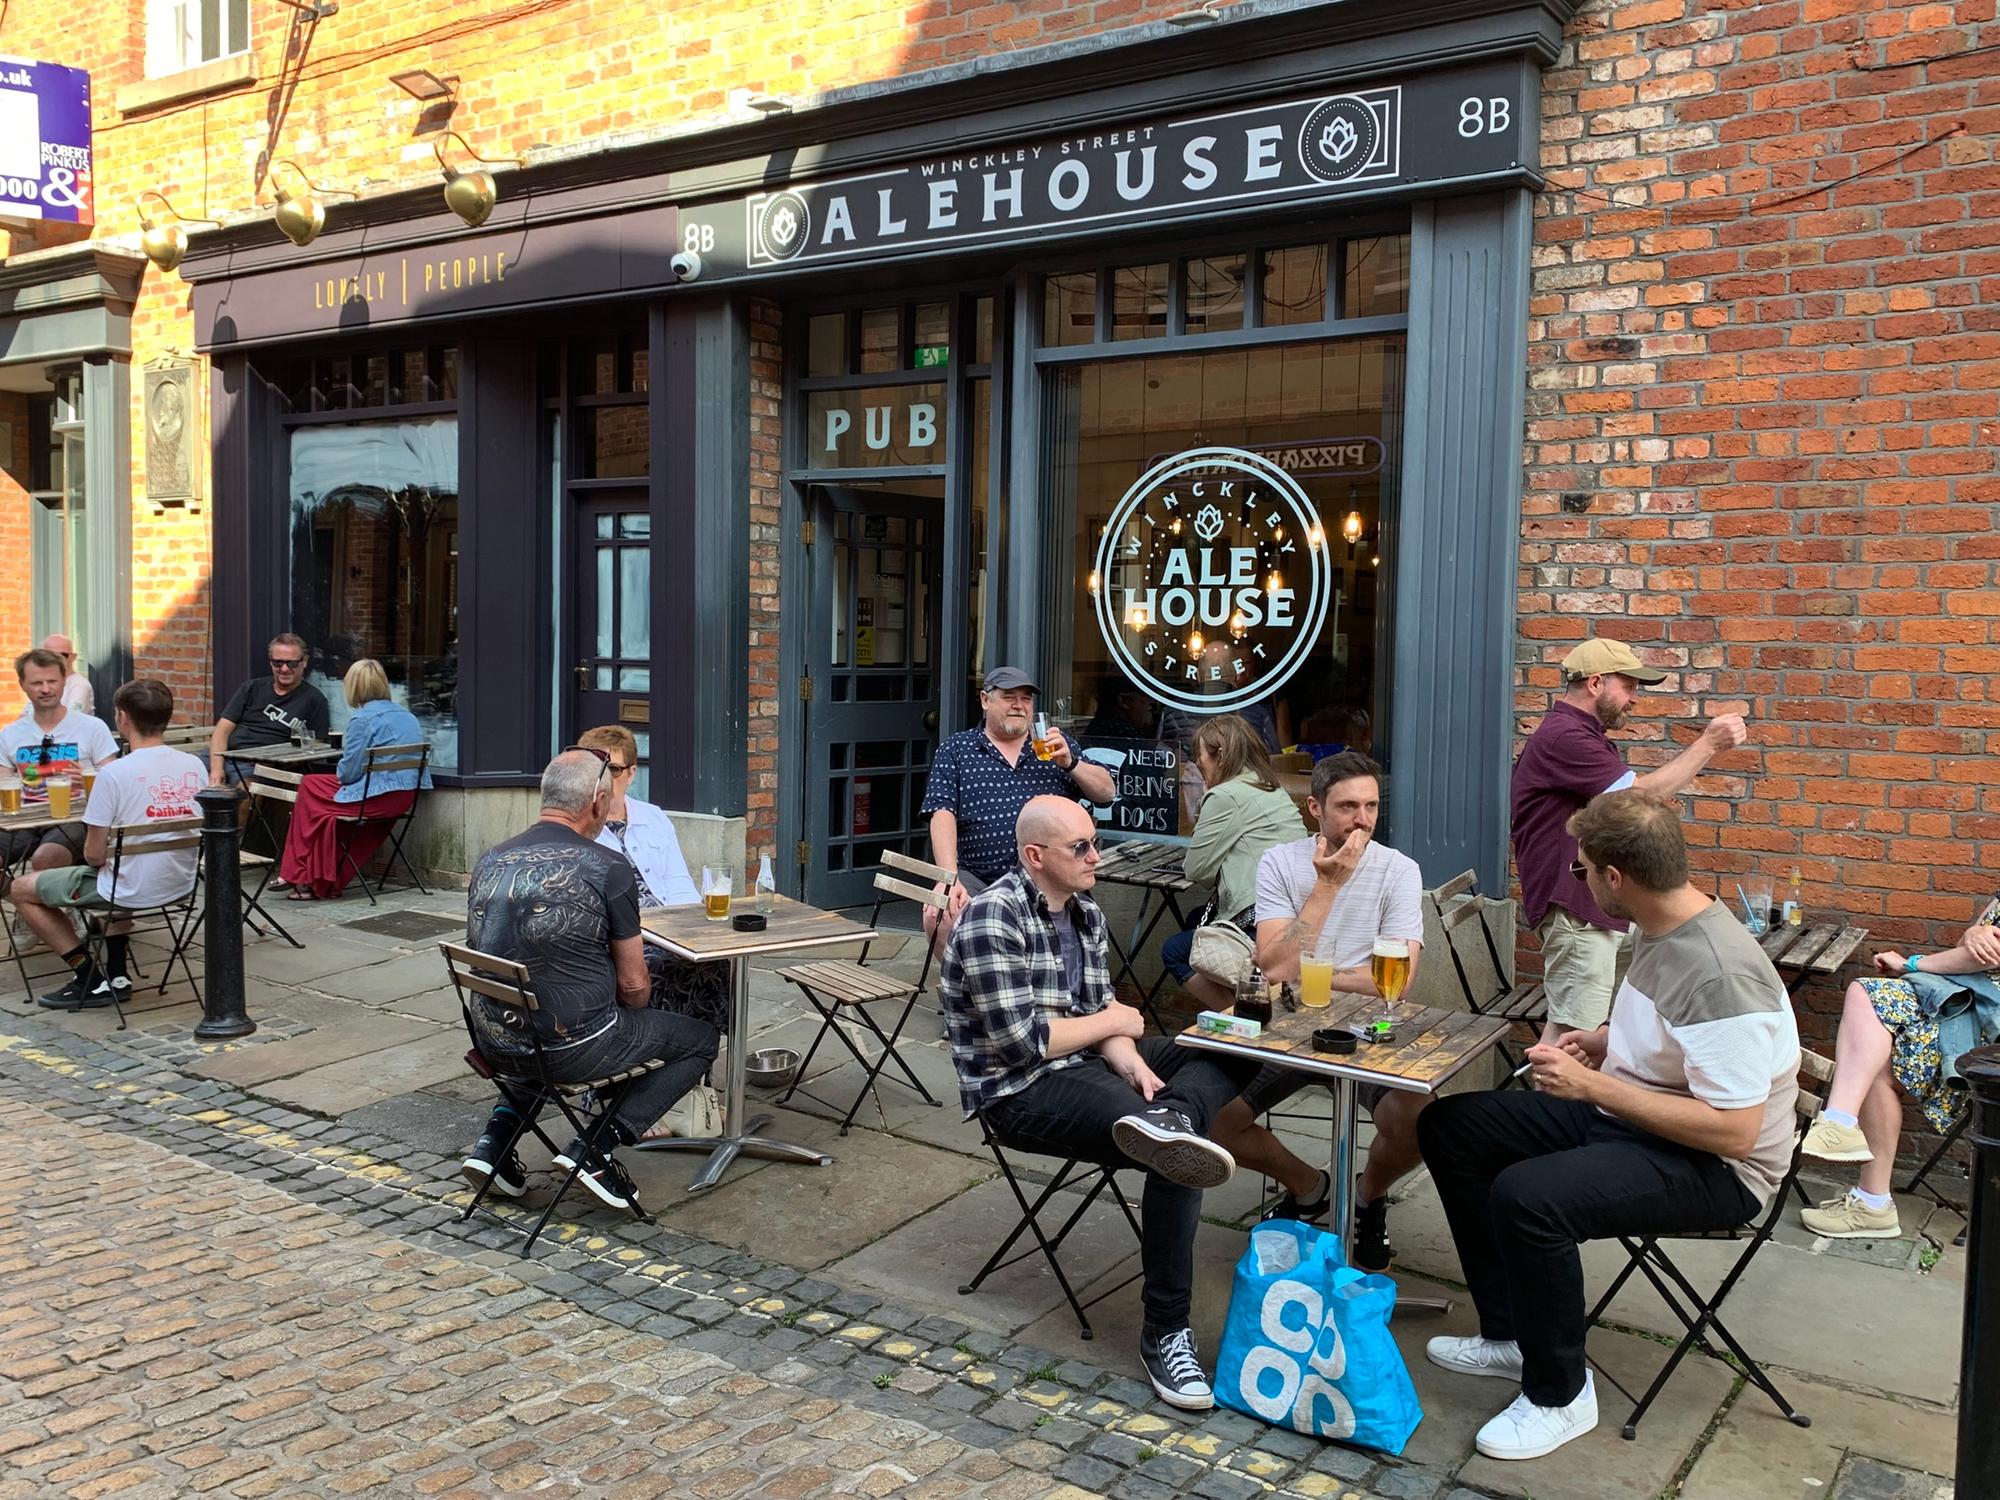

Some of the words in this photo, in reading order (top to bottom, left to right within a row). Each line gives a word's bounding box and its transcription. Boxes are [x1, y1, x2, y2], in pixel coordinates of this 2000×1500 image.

[0, 69, 32, 87] .uk
[1458, 96, 1510, 138] 8B
[41, 142, 90, 160] ROBERT
[41, 153, 90, 172] PINKUS
[921, 147, 1042, 177] WINCKLEY
[1061, 126, 1154, 154] STREET
[820, 124, 1284, 245] ALEHOUSE
[684, 223, 715, 252] 8B
[425, 252, 505, 293] PEOPLE
[825, 403, 937, 451] PUB
[1126, 481, 1296, 556] WINCKLEY
[1159, 547, 1258, 586] ALE
[1123, 587, 1296, 627] HOUSE
[1144, 641, 1267, 681] STREET
[1128, 748, 1176, 769] NEED
[1123, 774, 1175, 799] BRING
[1121, 805, 1168, 831] DOGS
